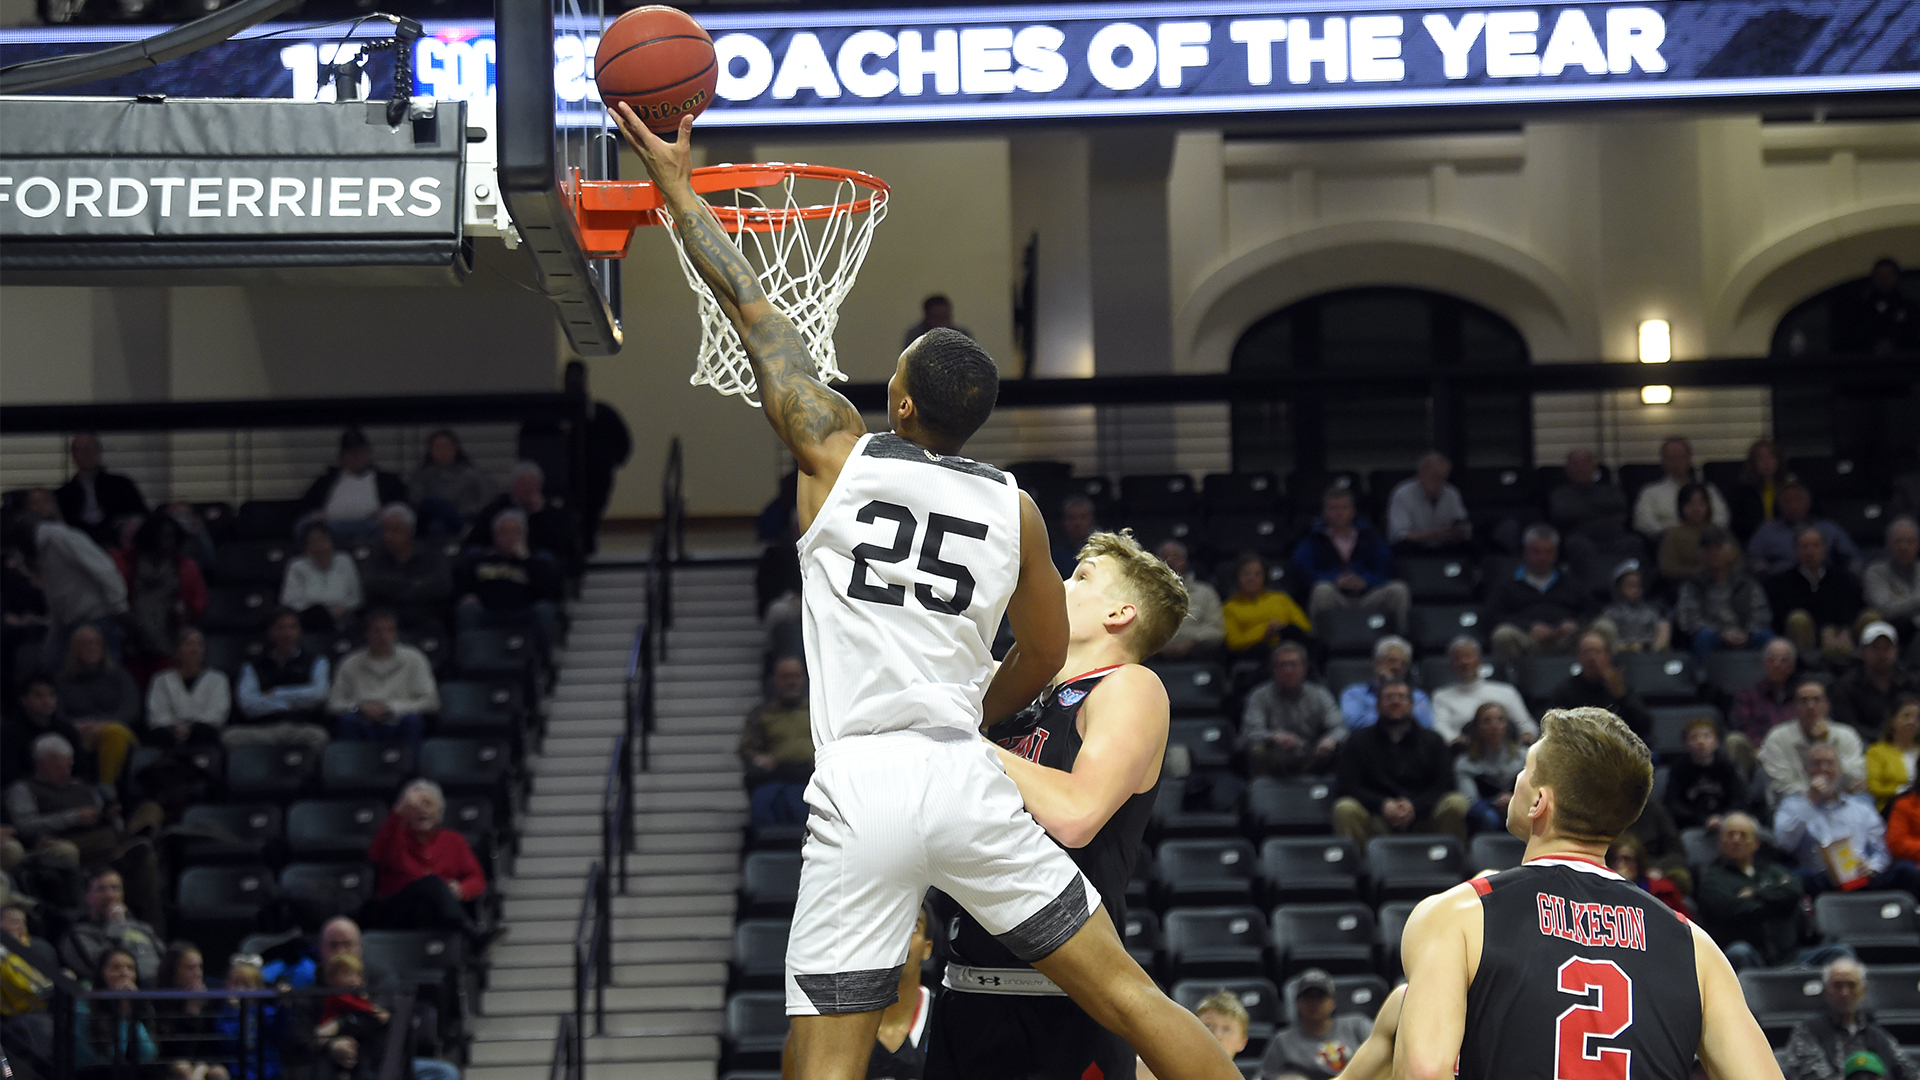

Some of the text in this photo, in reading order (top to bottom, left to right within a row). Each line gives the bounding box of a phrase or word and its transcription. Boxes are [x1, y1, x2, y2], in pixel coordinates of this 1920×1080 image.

[713, 25, 1069, 101] OACHES
[1087, 21, 1212, 91] OF
[1229, 15, 1405, 86] THE
[1422, 7, 1669, 79] YEAR
[847, 499, 989, 616] 25
[1536, 892, 1647, 951] GILKESON
[1554, 955, 1633, 1080] 2
